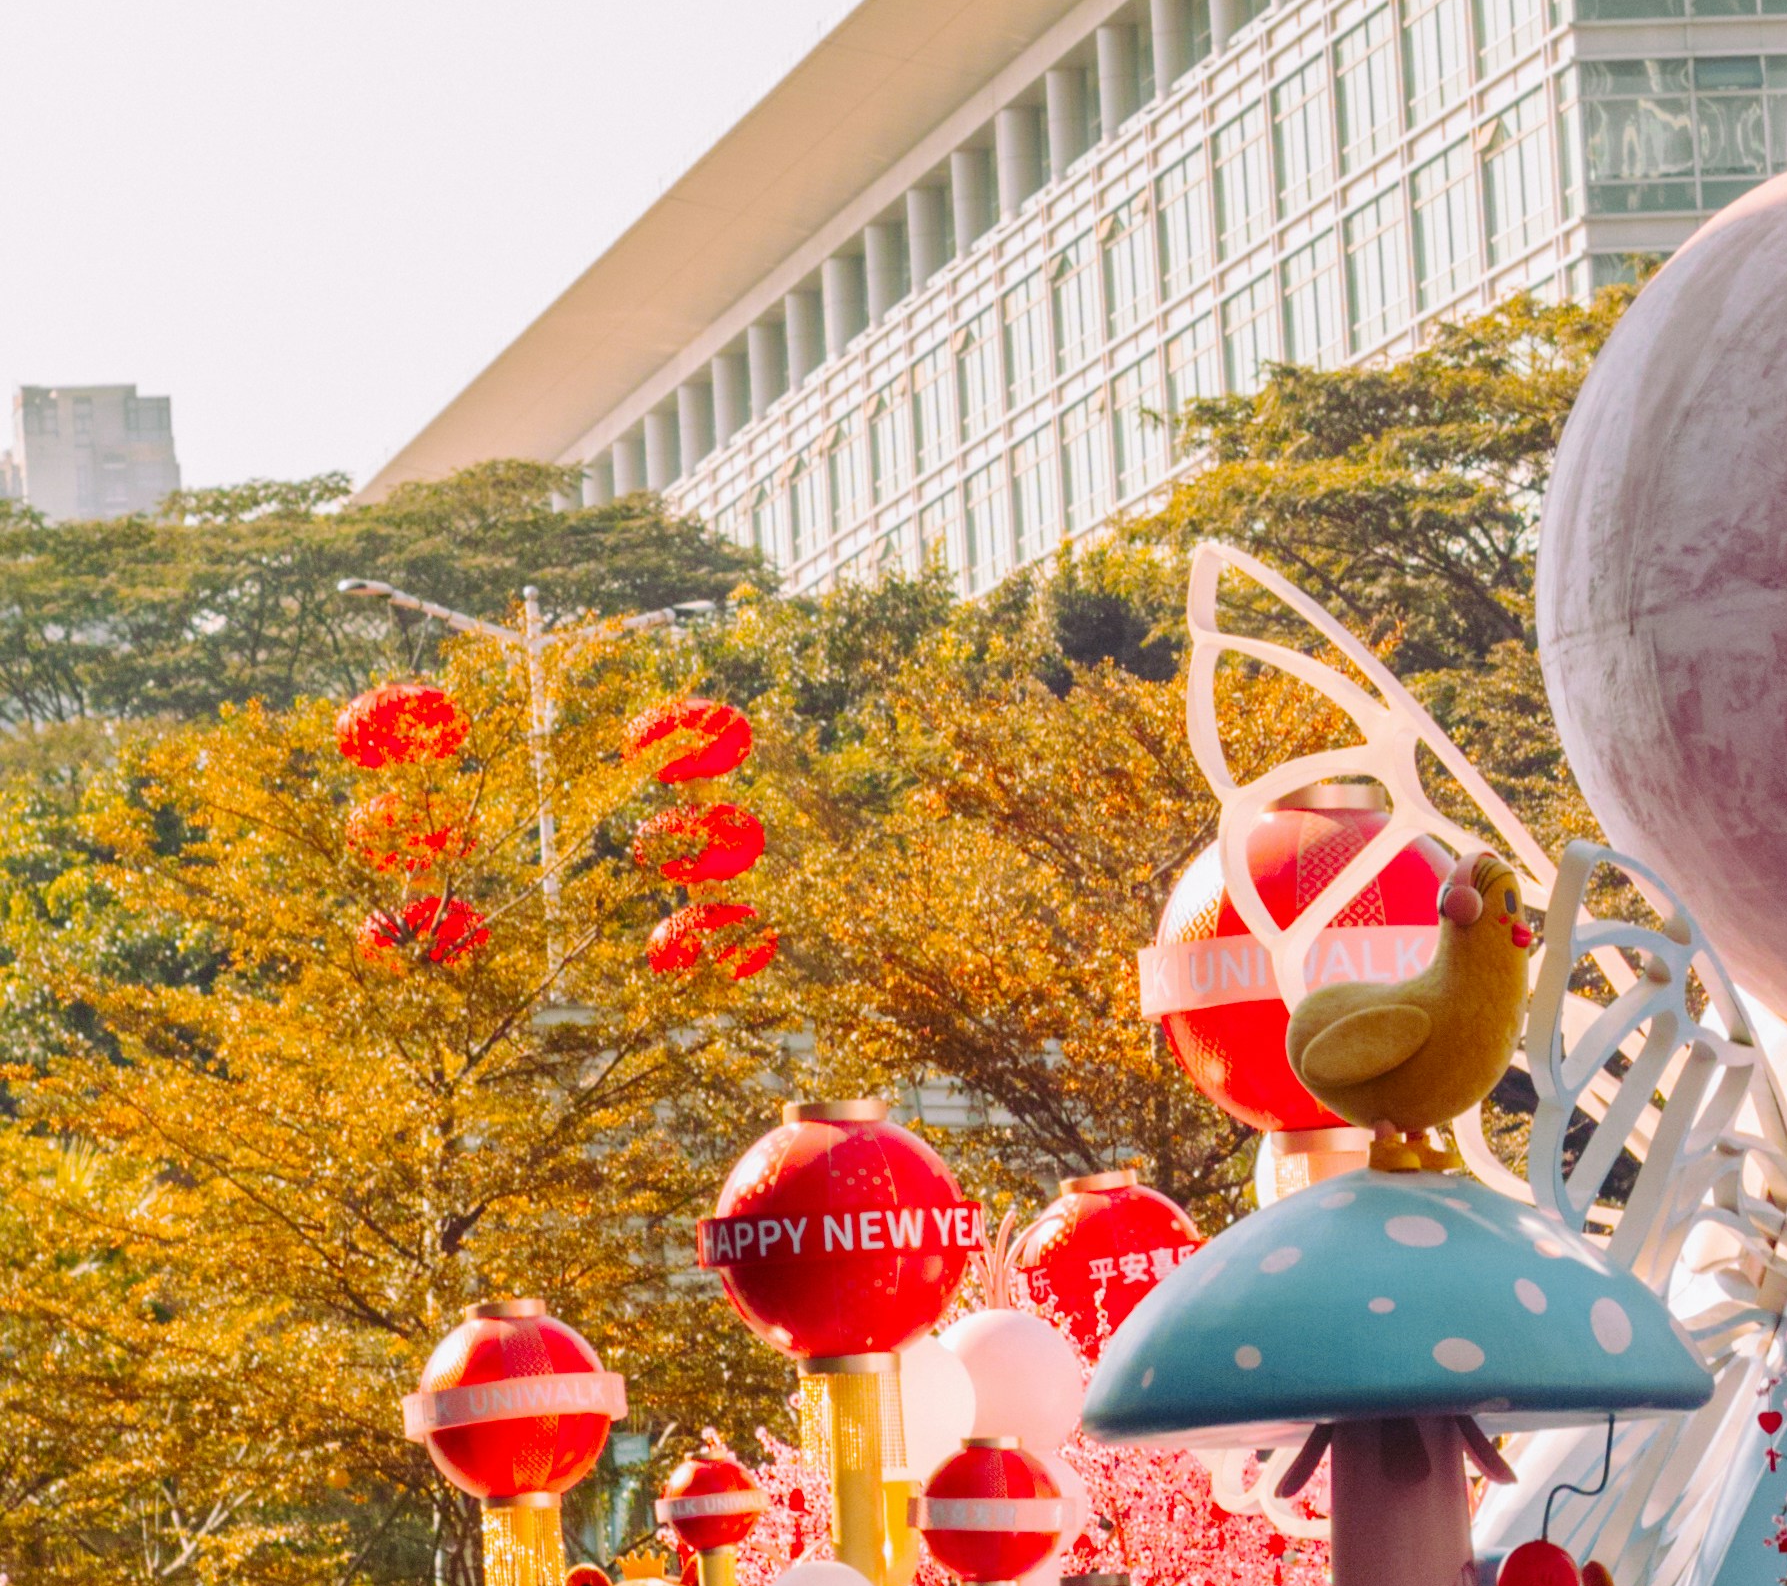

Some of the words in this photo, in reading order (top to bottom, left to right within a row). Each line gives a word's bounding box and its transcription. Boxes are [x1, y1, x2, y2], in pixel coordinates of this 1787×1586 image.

[702, 1216, 807, 1262] HAPPY
[823, 1210, 925, 1252] NEW
[469, 1380, 607, 1415] UNIWALK
